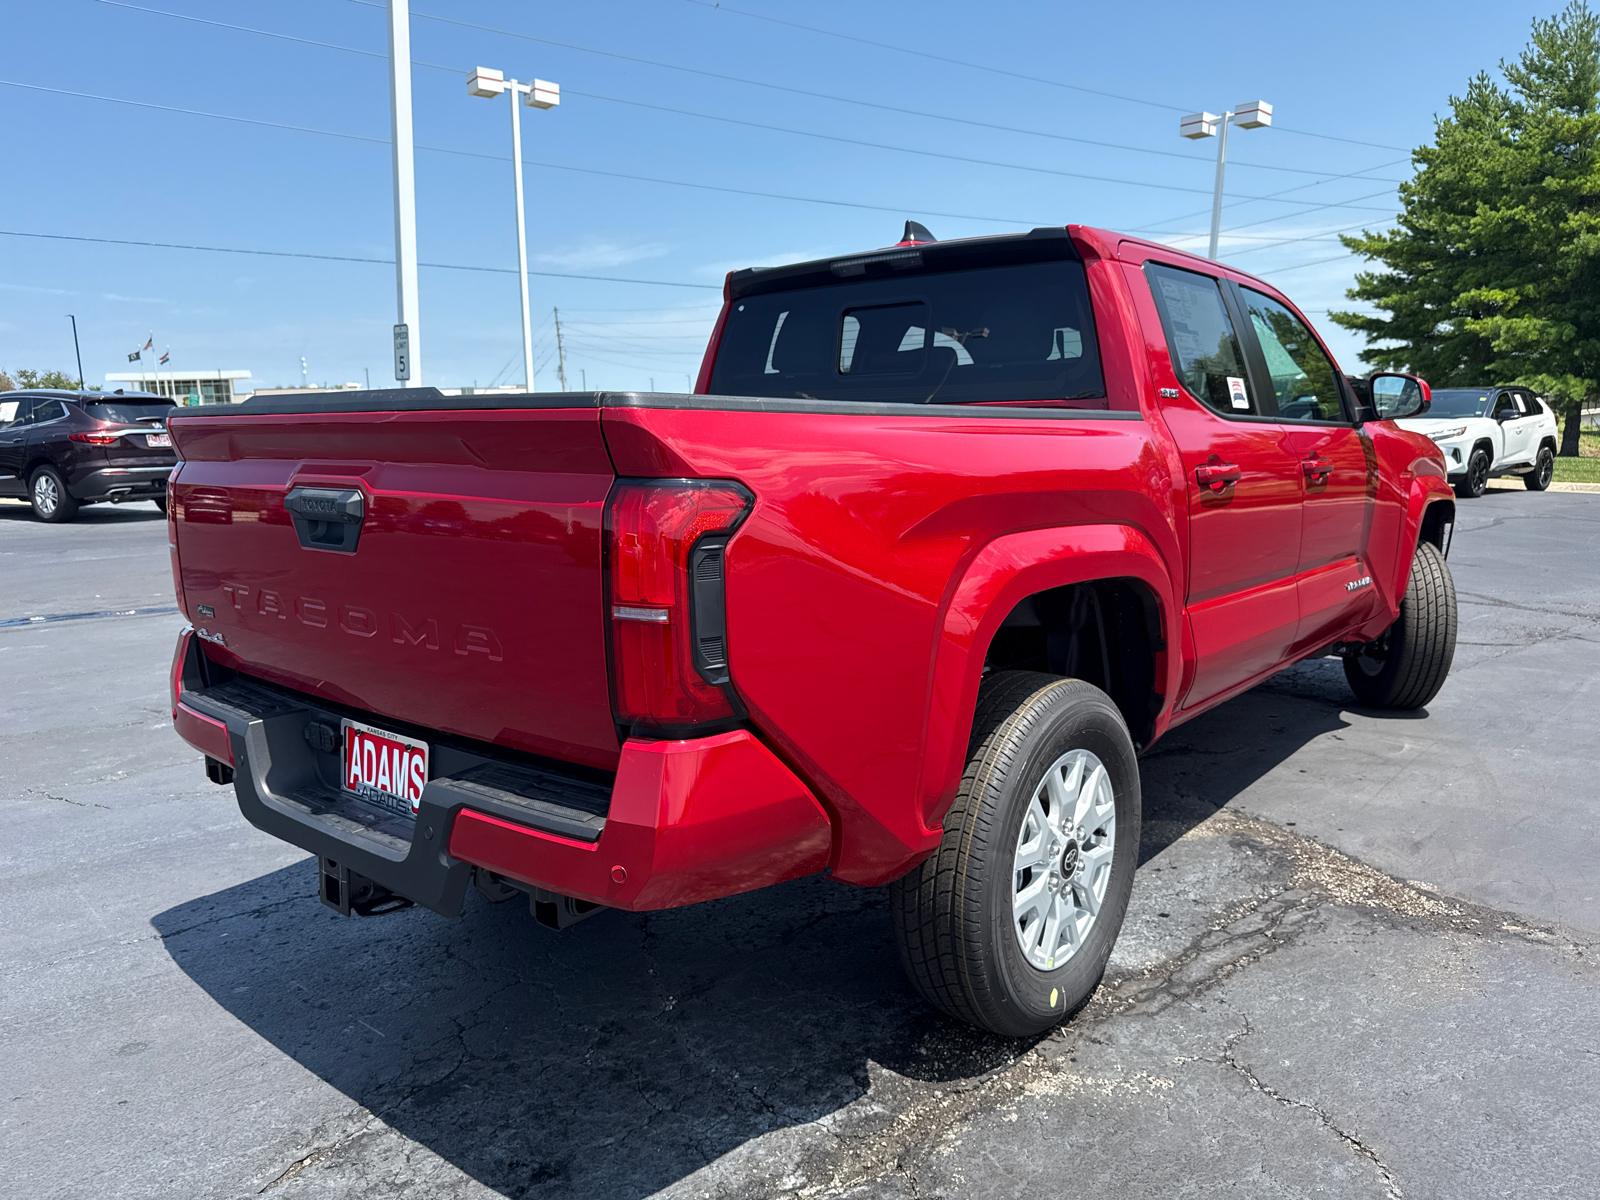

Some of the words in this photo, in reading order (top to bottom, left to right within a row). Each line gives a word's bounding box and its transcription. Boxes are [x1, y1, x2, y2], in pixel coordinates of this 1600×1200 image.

[399, 355, 406, 373] 5
[301, 498, 338, 514] TOYOTA
[220, 579, 503, 662] TACOMA
[366, 726, 387, 738] KANSAS
[387, 732, 399, 741] CITY
[349, 736, 425, 809] ADAMS
